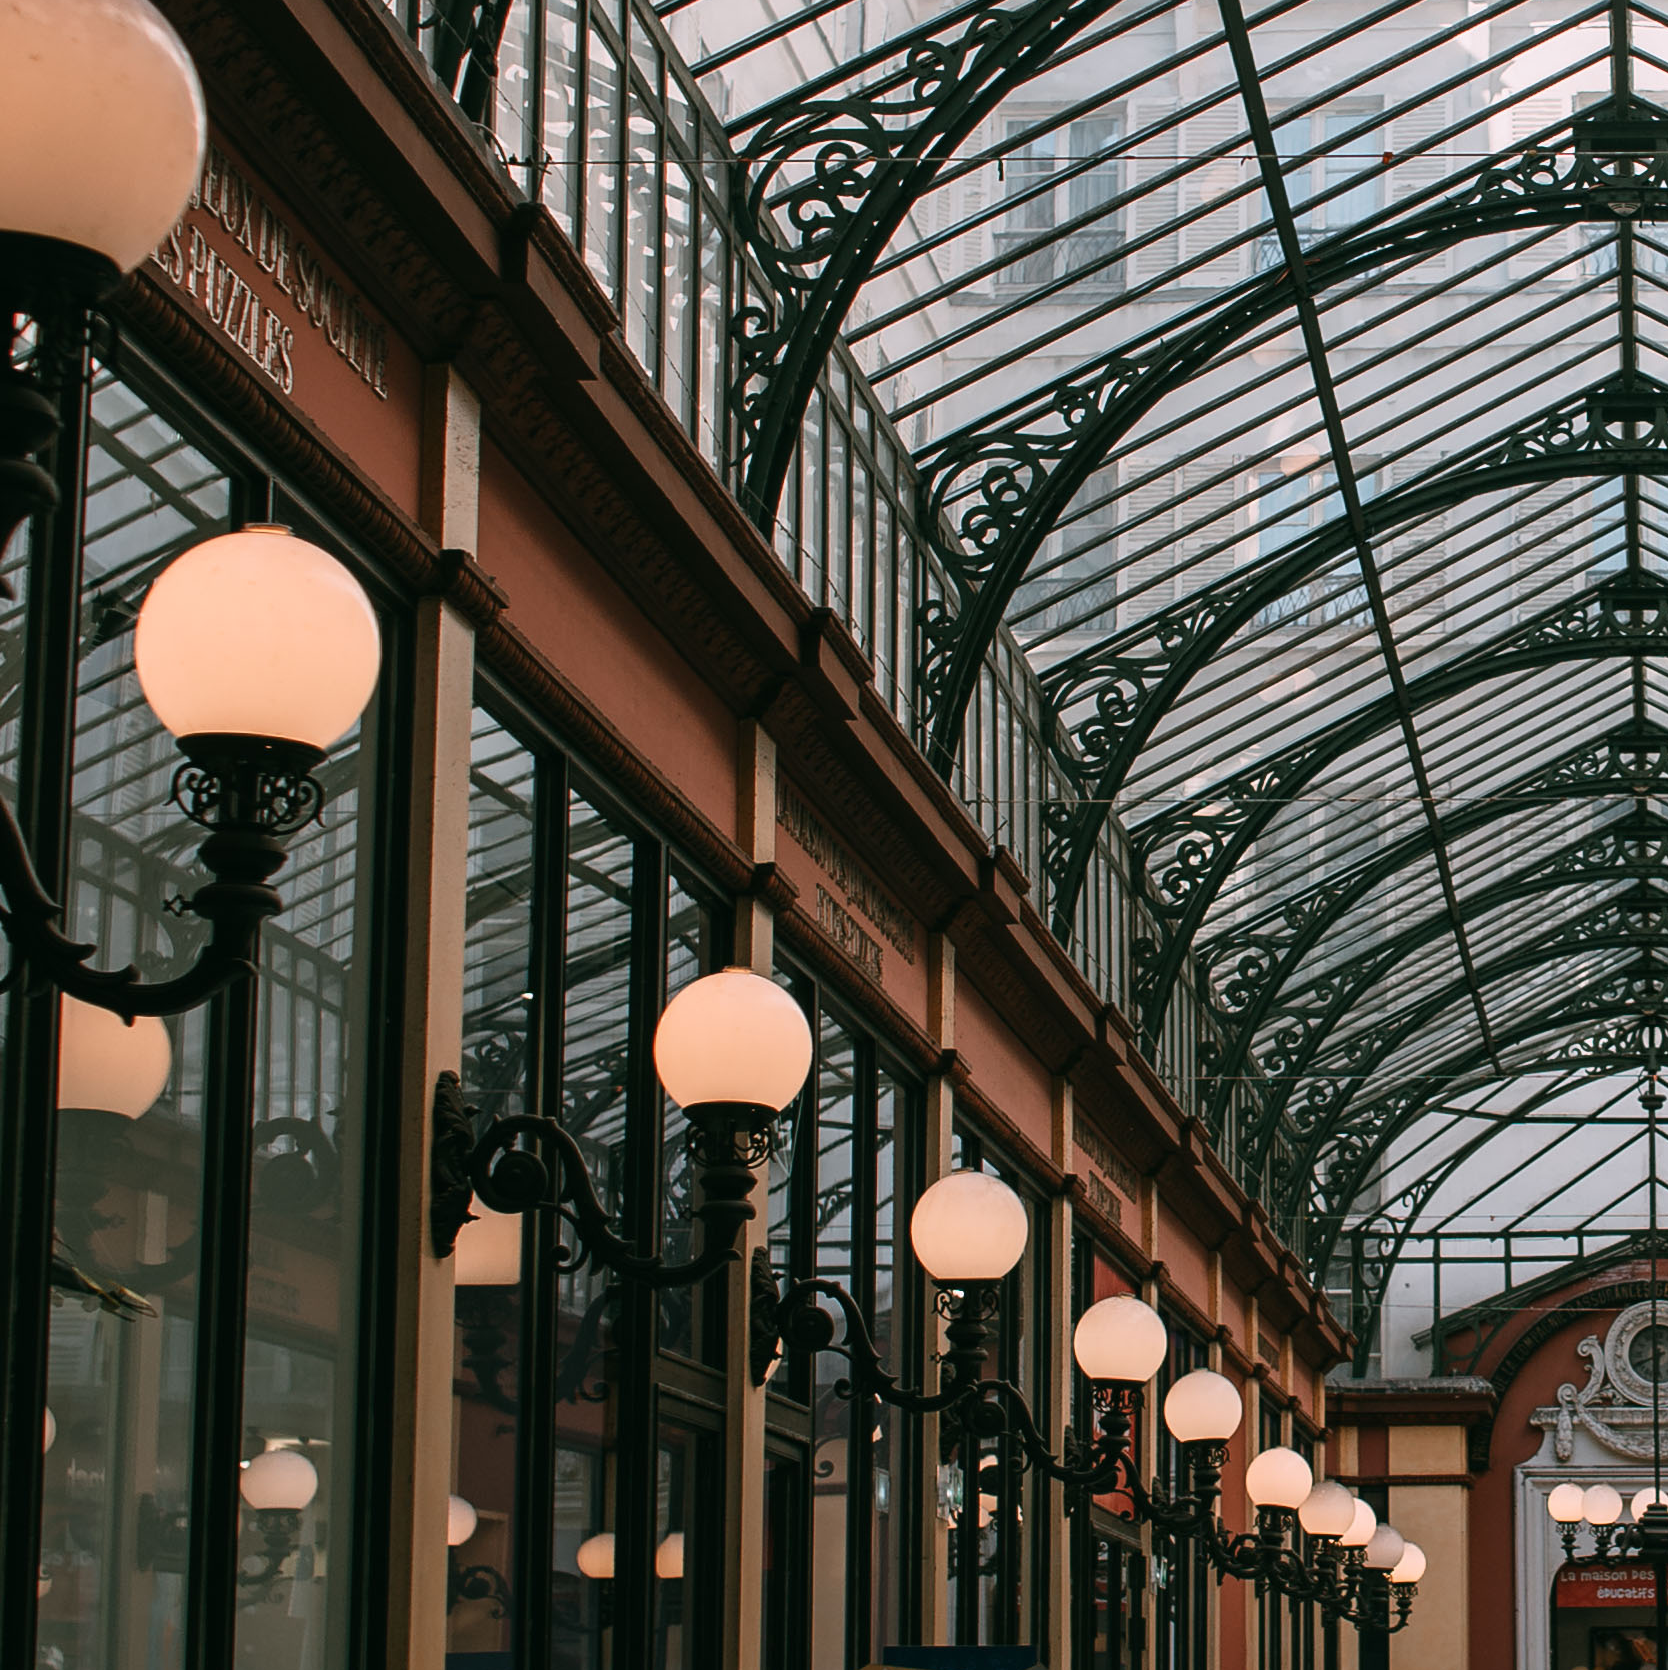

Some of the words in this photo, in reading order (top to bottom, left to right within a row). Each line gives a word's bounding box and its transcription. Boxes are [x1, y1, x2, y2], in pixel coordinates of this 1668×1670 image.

[256, 199, 292, 295] DE
[186, 224, 293, 395] PUZZLES
[1561, 1570, 1576, 1582] La
[1580, 1569, 1627, 1581] maison
